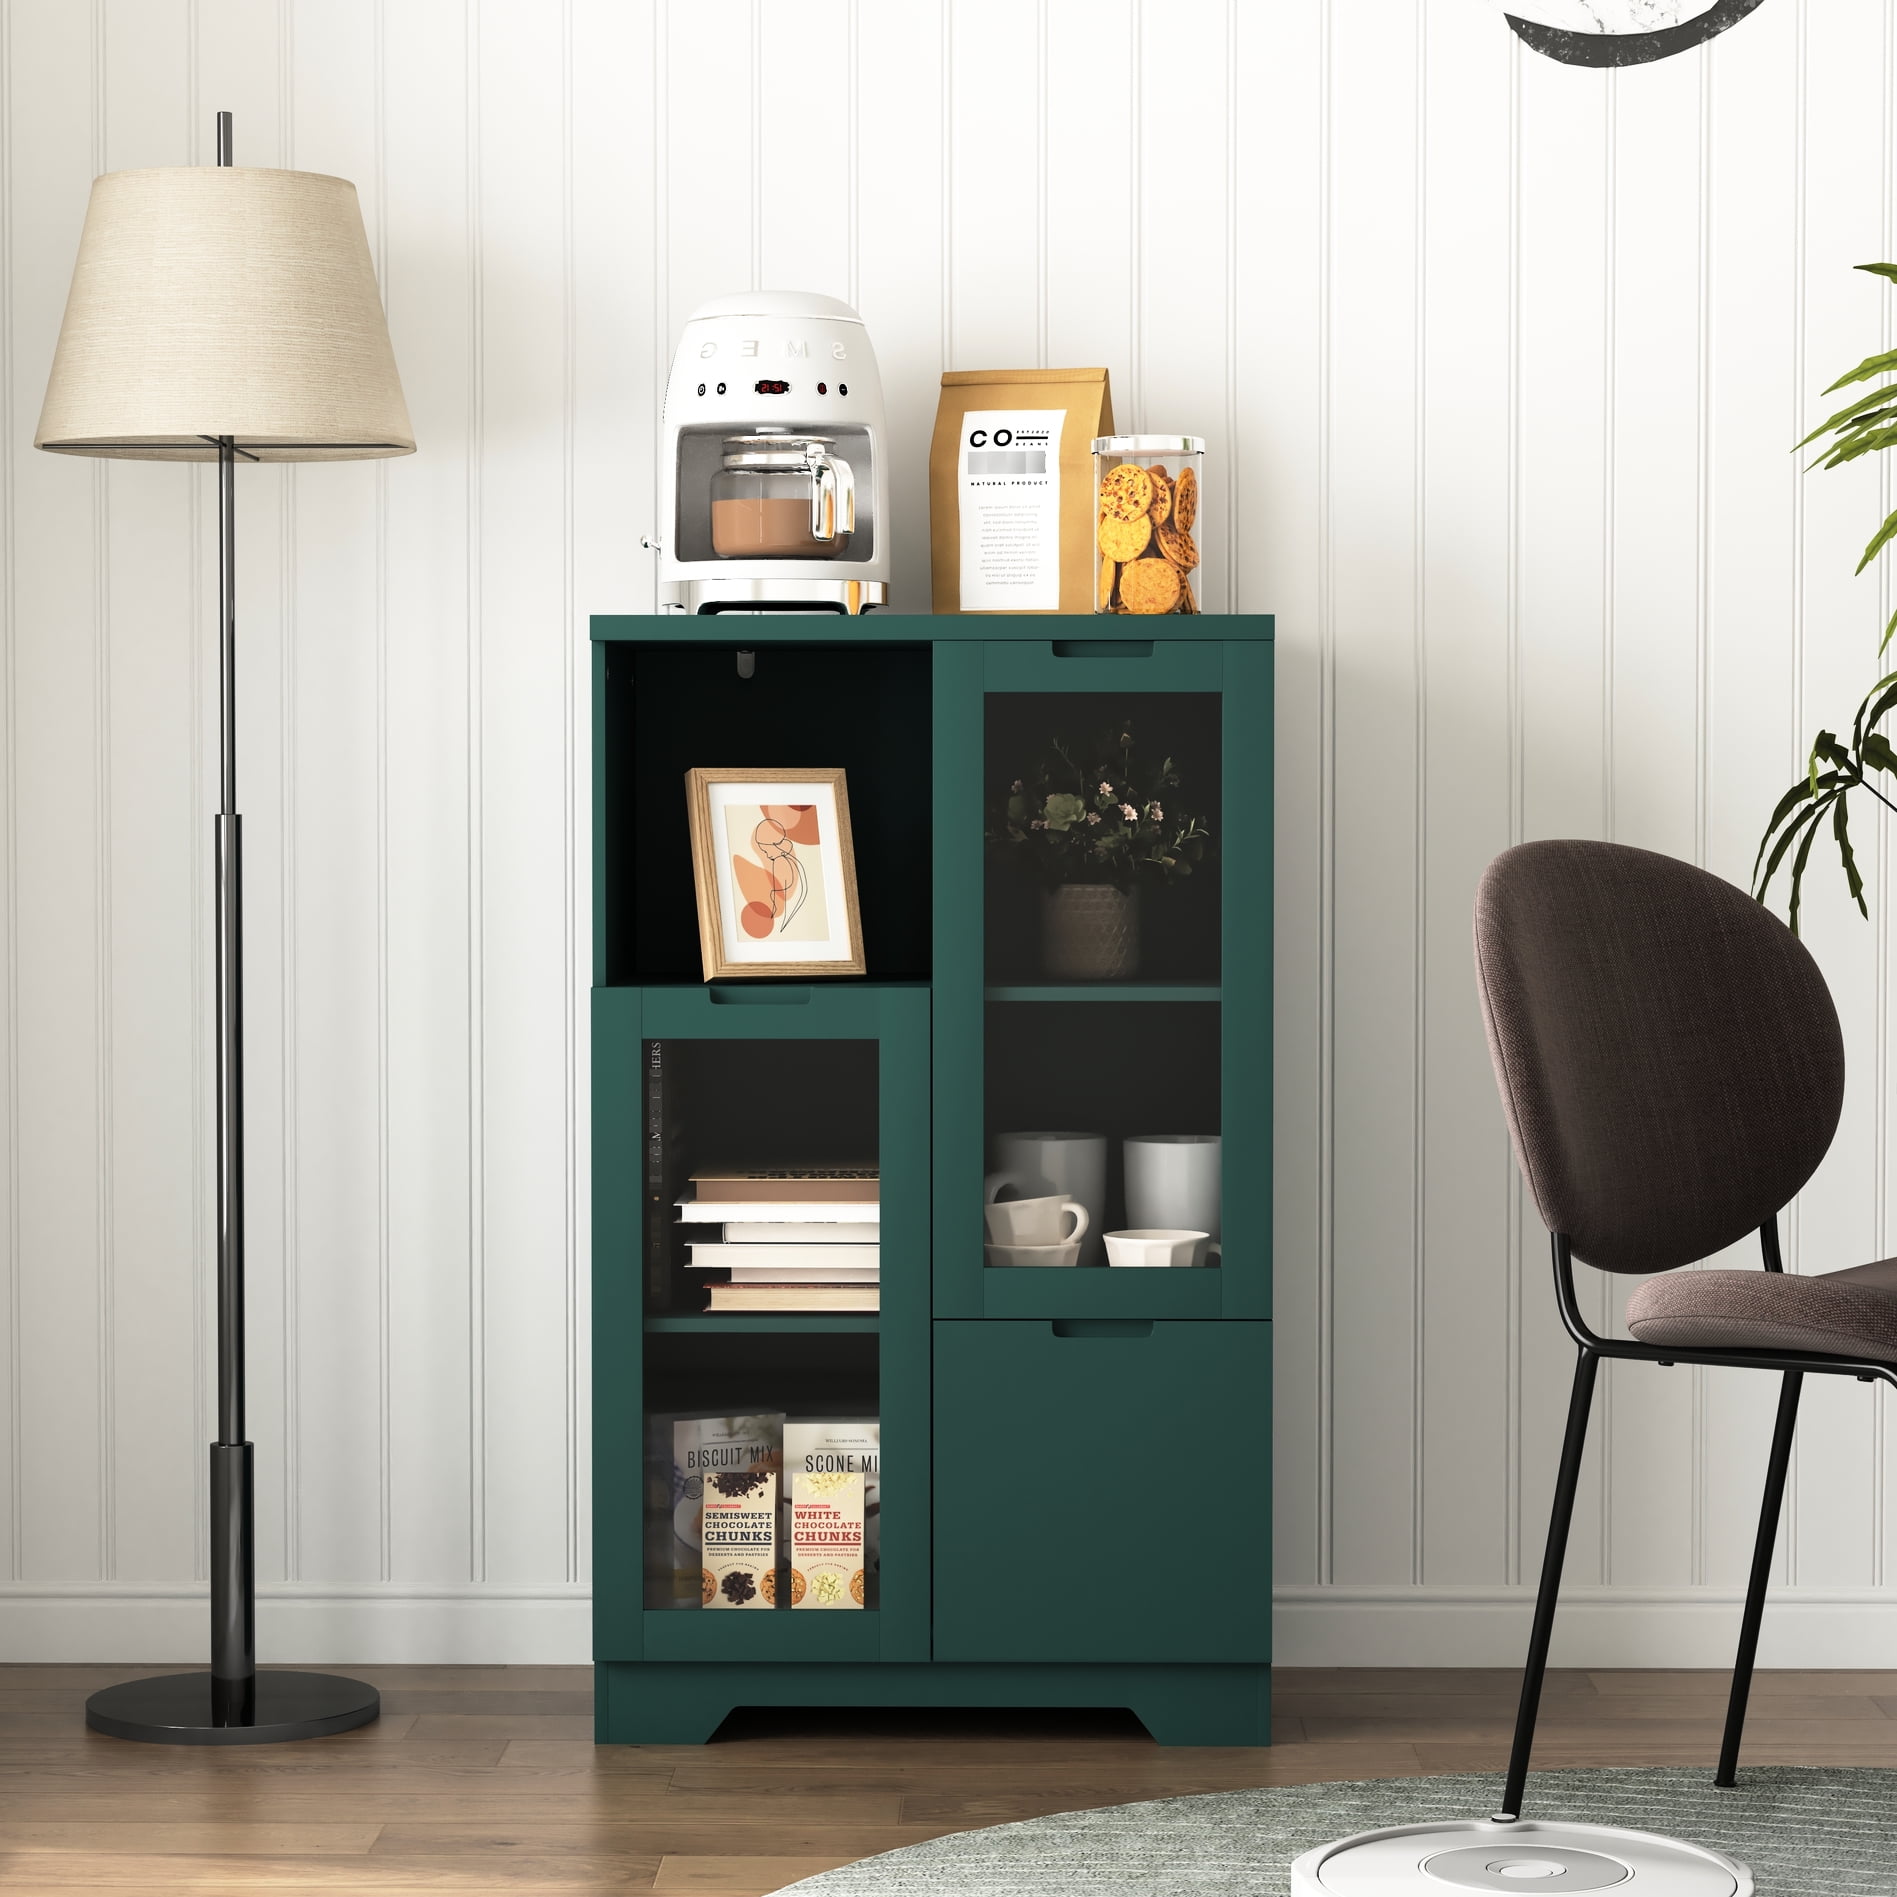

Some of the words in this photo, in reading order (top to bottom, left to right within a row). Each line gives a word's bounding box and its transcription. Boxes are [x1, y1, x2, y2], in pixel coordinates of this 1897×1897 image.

[687, 1447, 742, 1469] BISCUIT
[750, 1445, 774, 1464] MIX
[805, 1454, 854, 1473] SCONE
[705, 1512, 772, 1520] SEMISWEET
[794, 1511, 841, 1520] WHITE
[705, 1521, 772, 1529] CHOCOLATE
[705, 1531, 772, 1541] CHUNKS
[794, 1531, 862, 1541] CHUNKS
